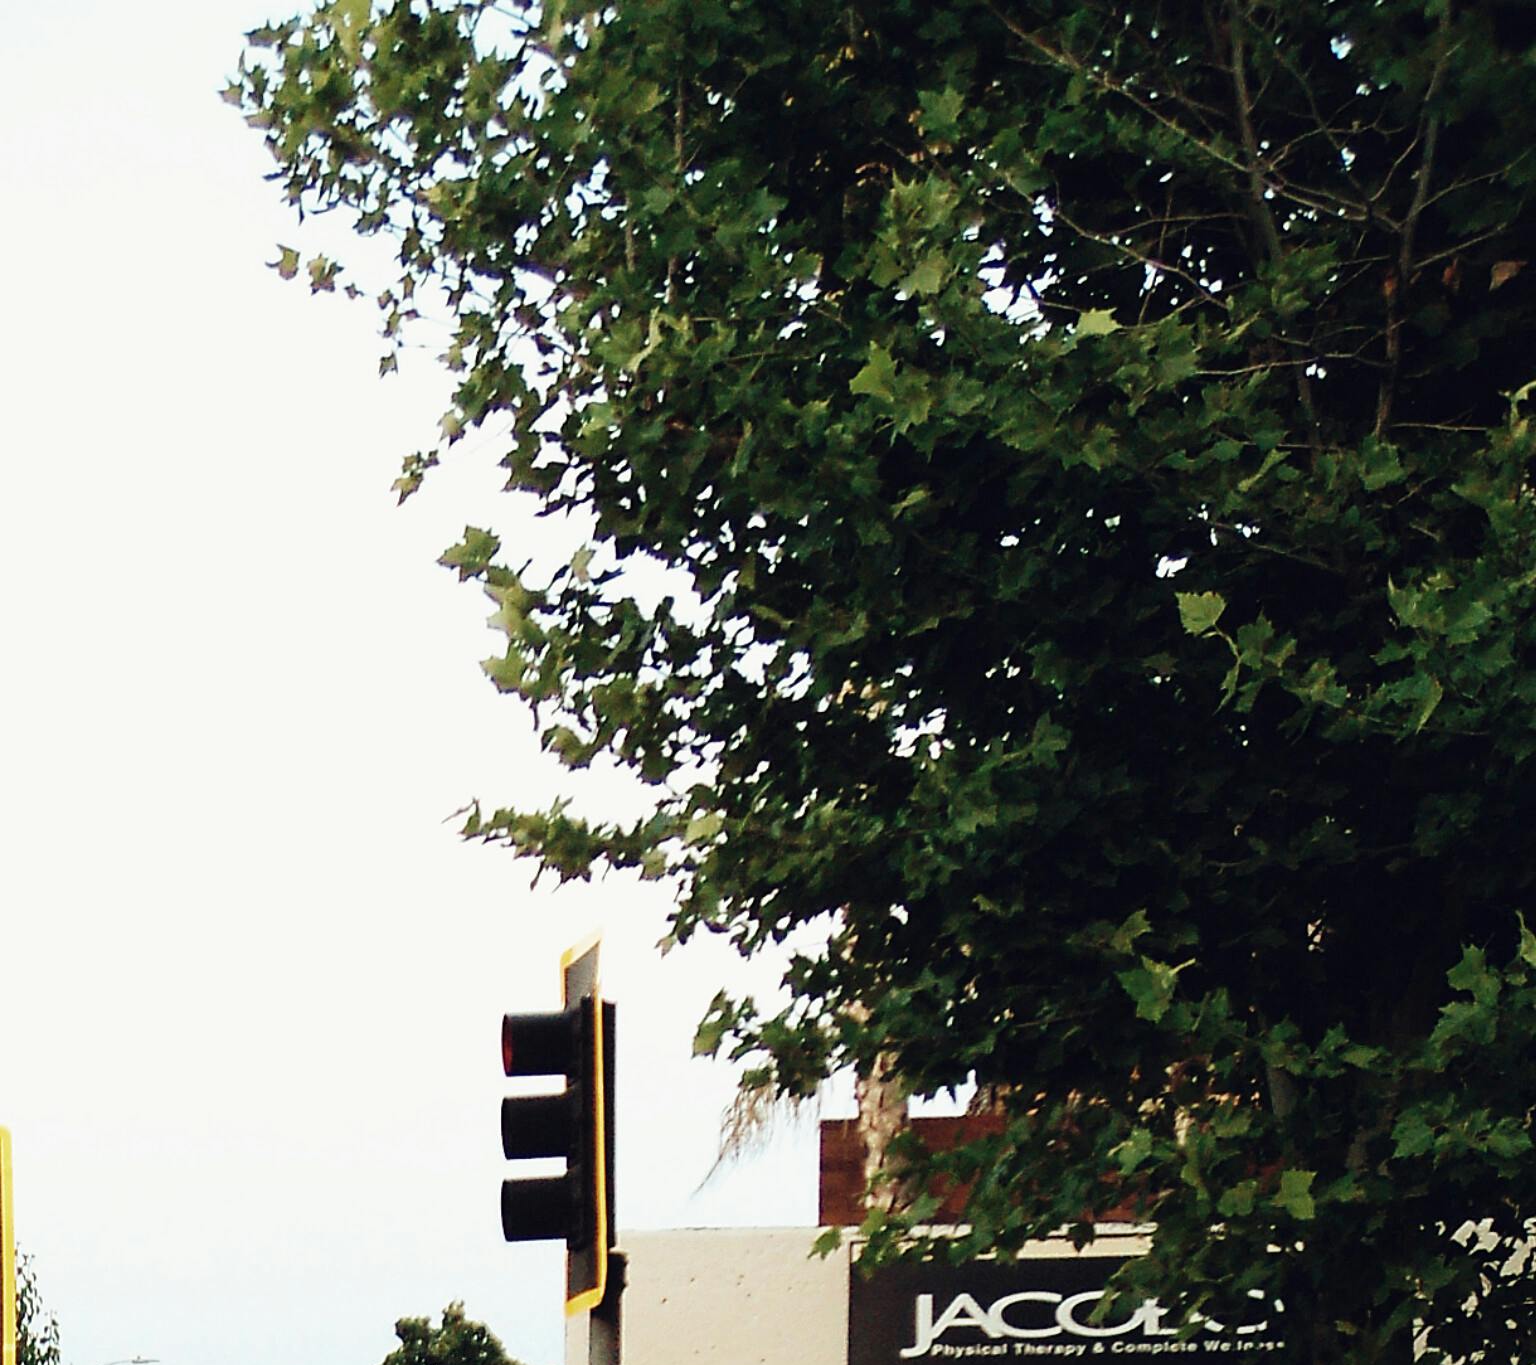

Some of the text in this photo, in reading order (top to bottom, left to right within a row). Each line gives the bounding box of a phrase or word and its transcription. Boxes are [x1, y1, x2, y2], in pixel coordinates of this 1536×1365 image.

[931, 1342, 1008, 1358] Physical
[1013, 1342, 1086, 1357] Therapy
[1092, 1342, 1105, 1354] &
[1111, 1341, 1198, 1355] Complete
